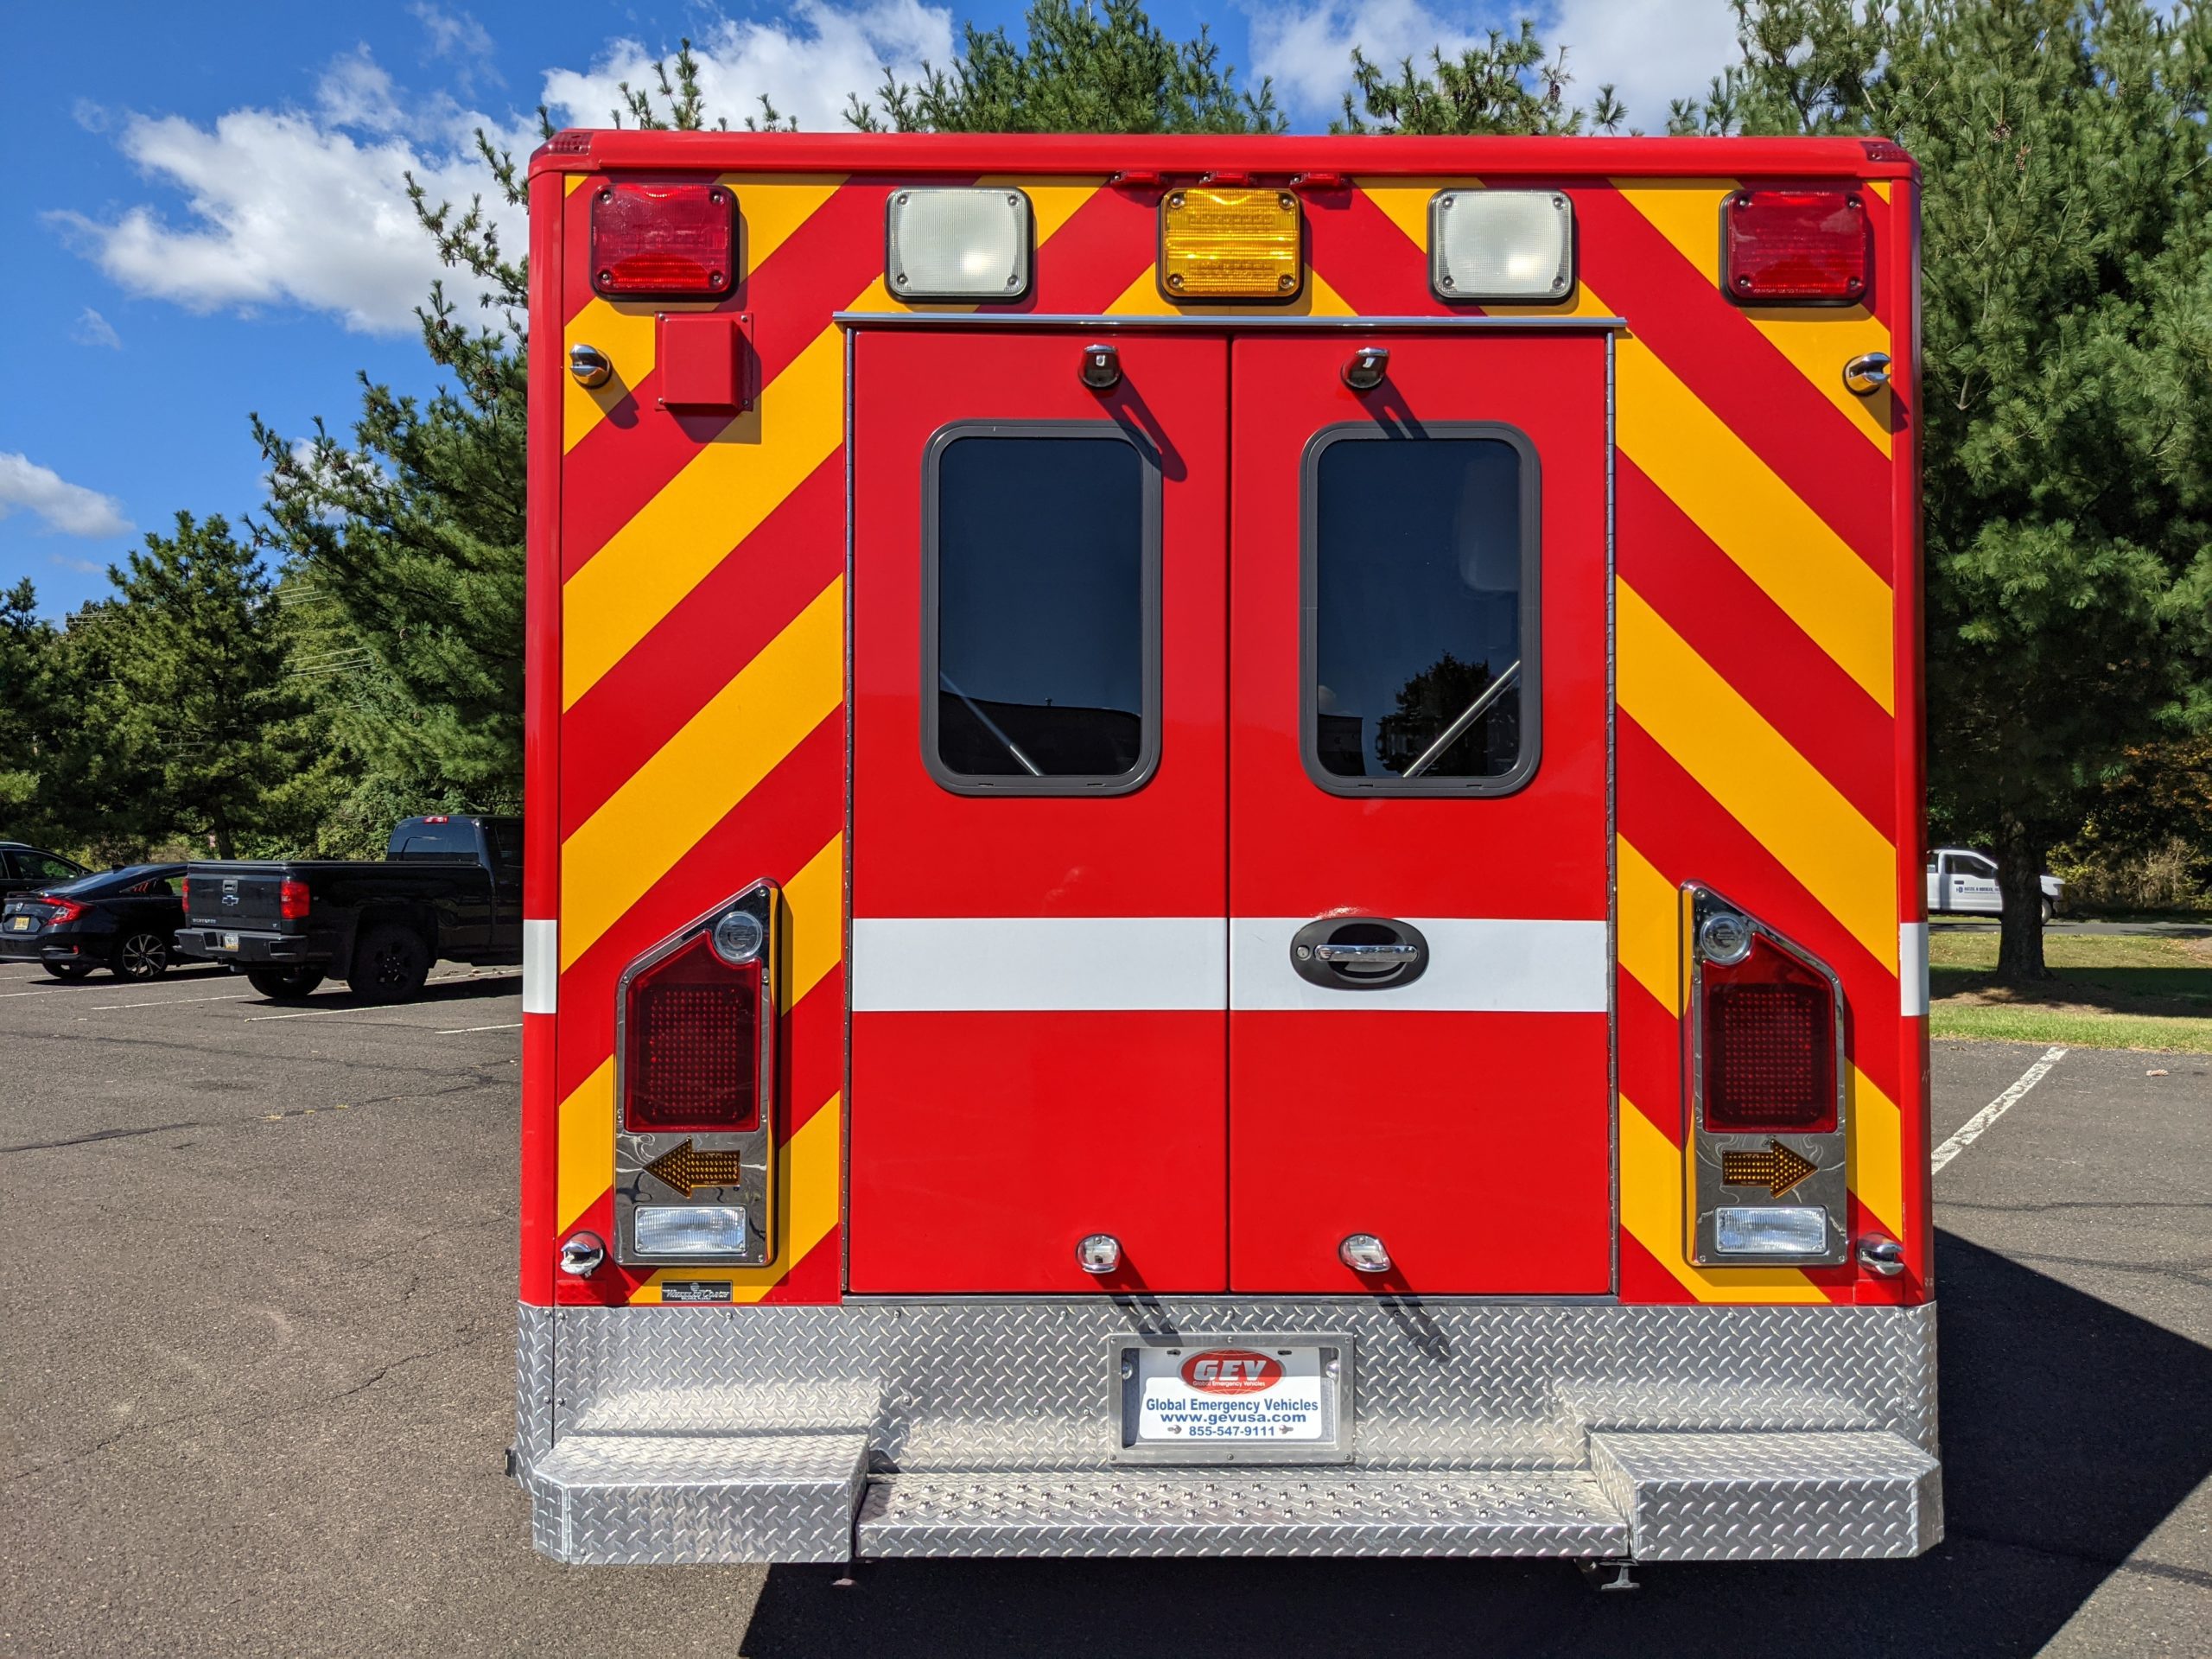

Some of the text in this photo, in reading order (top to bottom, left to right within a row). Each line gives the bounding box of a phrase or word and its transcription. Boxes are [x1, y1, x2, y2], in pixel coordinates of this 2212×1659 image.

[1193, 1359, 1267, 1381] GEV
[1146, 1398, 1319, 1414] Global Emergency Vehicles
[1160, 1414, 1306, 1426] www.gevusa.com
[1188, 1426, 1275, 1437] 855-547-9111
